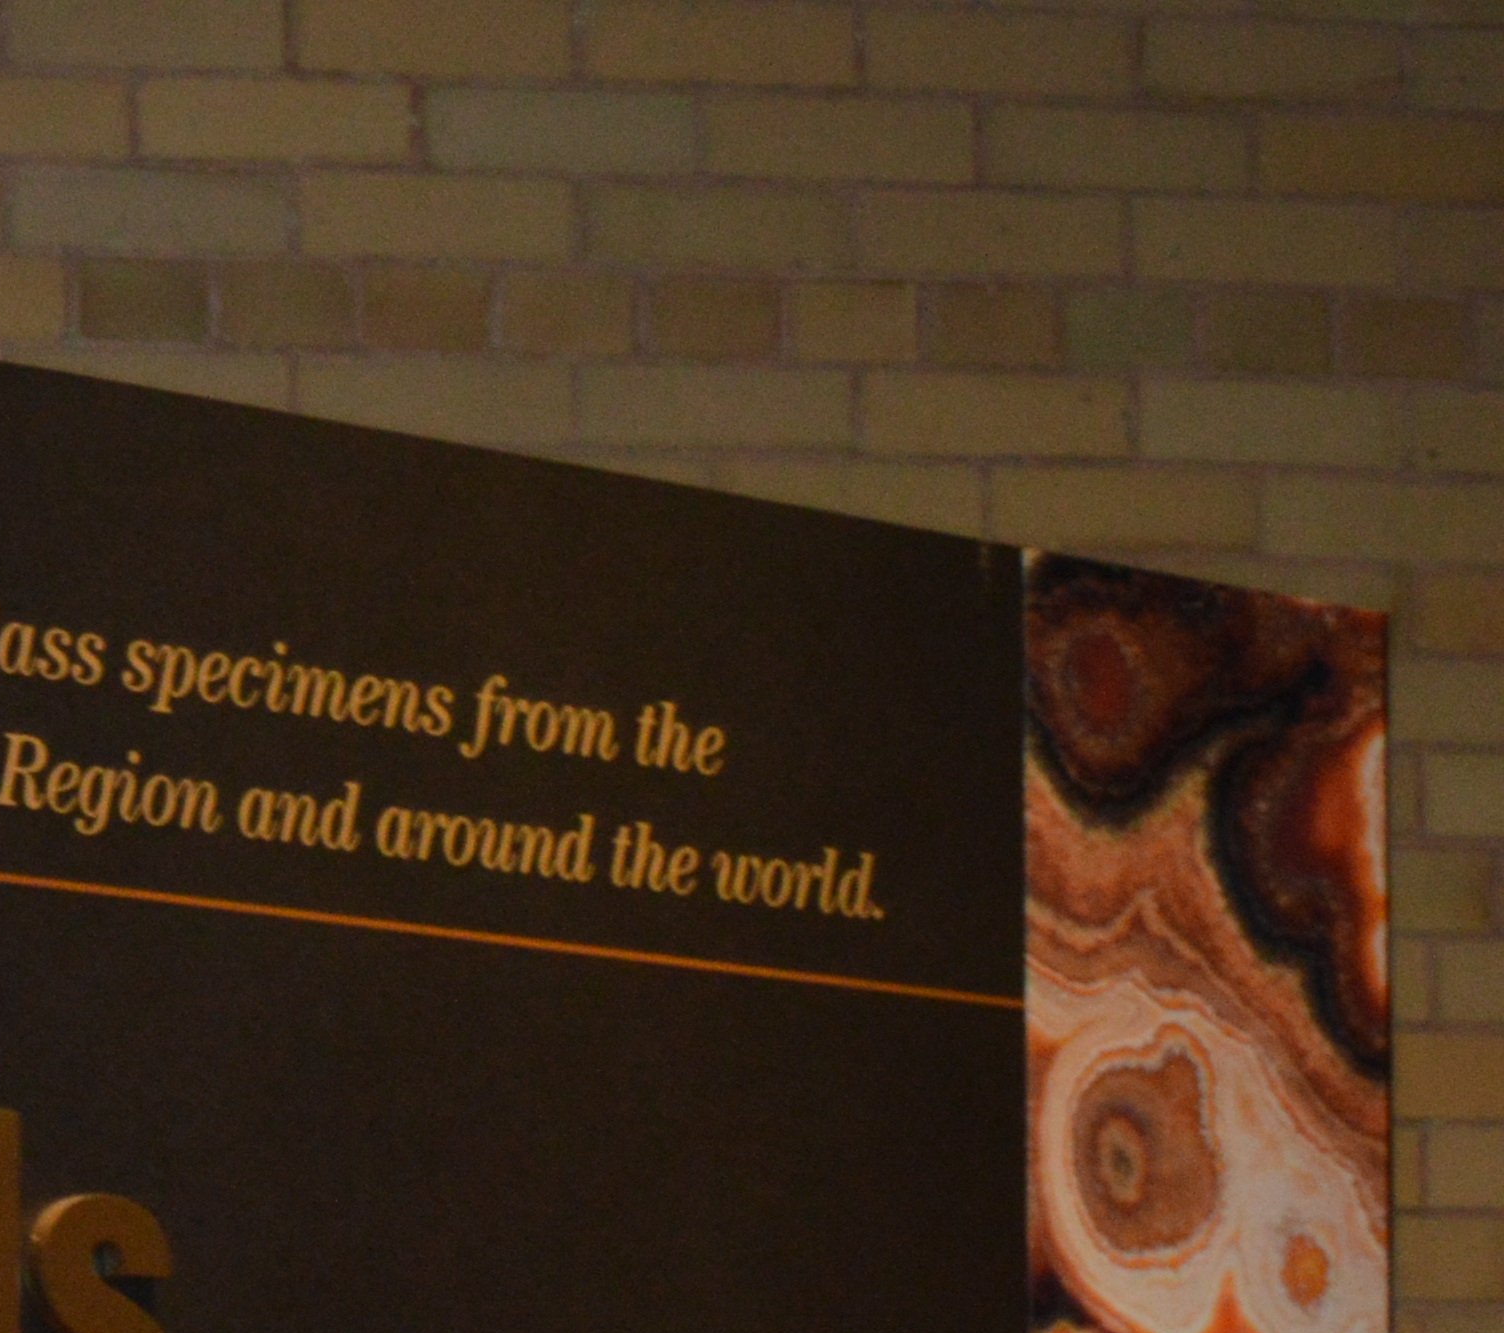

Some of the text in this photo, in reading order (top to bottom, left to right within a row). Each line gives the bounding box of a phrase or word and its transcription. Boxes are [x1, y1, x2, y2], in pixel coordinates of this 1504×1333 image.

[122, 639, 456, 737] specimens
[459, 674, 619, 761] from
[635, 700, 726, 776] the
[238, 780, 362, 852] and
[376, 806, 596, 883] around
[611, 821, 702, 895] the
[711, 846, 885, 920] world.
